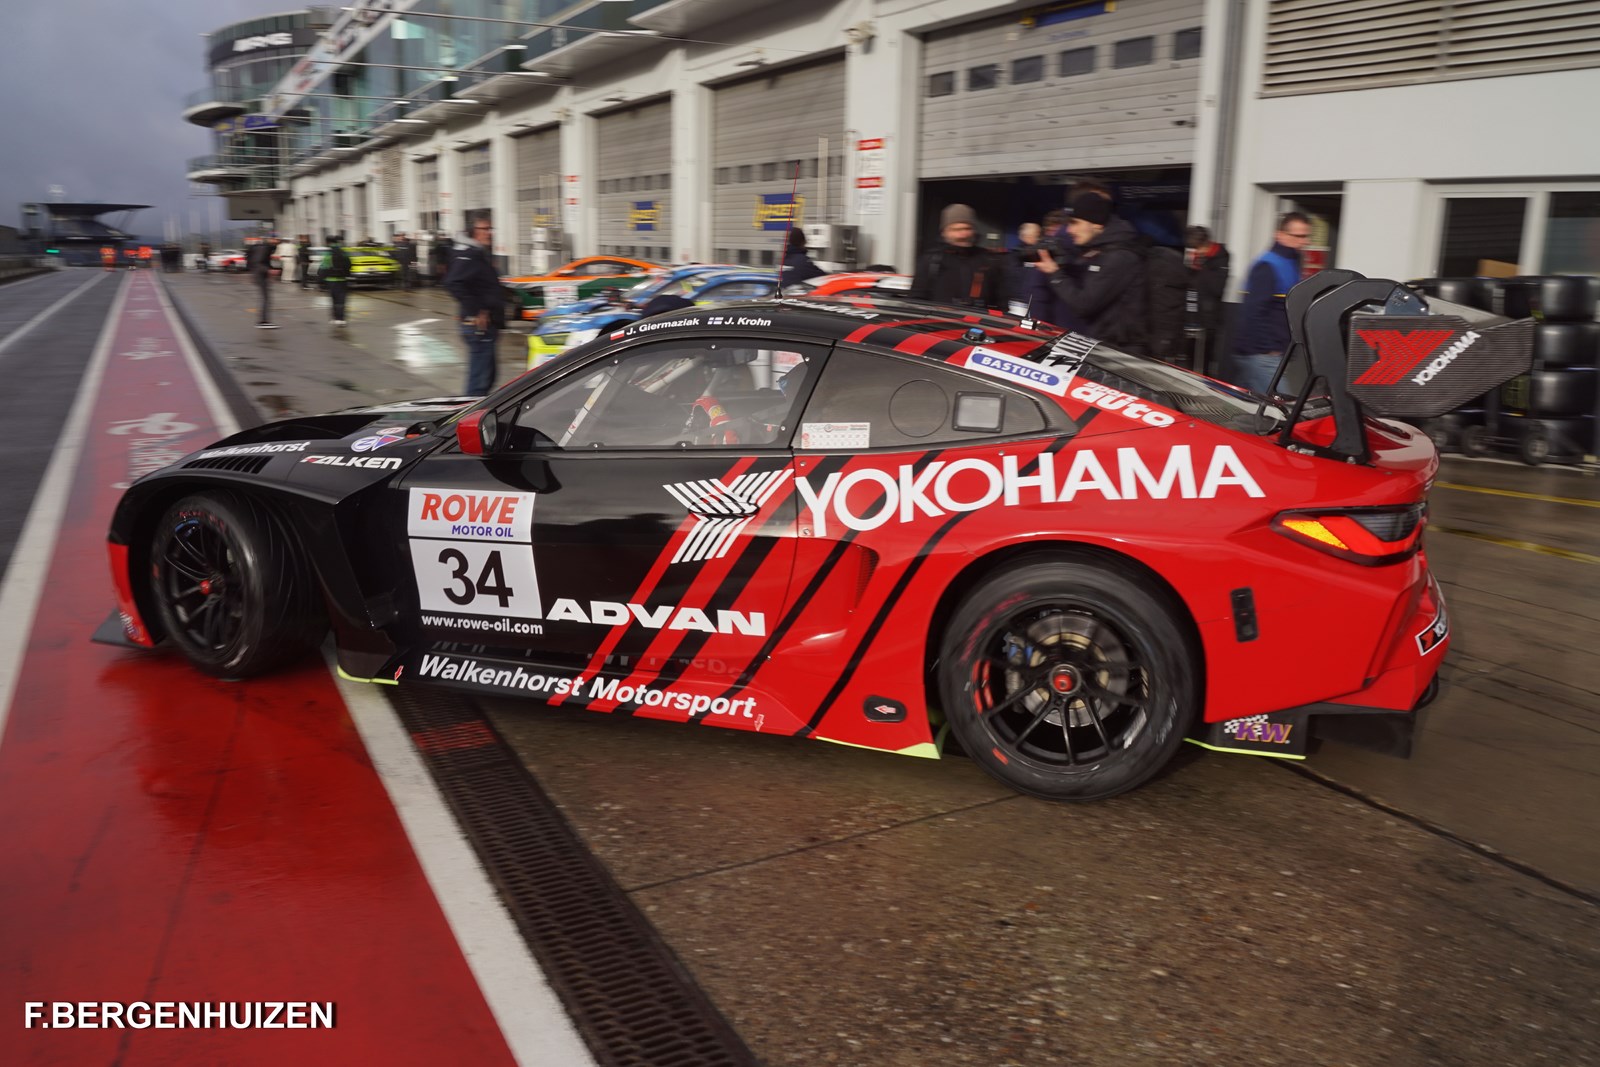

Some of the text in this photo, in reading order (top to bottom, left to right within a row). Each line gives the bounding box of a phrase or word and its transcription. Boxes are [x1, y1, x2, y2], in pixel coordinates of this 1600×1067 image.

[626, 317, 700, 336] J. Giermaziak
[724, 316, 771, 327] J. Krohn
[981, 356, 1053, 384] BASTUCK
[1411, 330, 1482, 386] YOKOHAMA
[1070, 387, 1176, 428] auto
[300, 455, 402, 470] FALKEN
[794, 445, 1266, 537] YOKOHAMA
[420, 493, 520, 524] ROWE
[452, 525, 514, 537] MOTOR OIL
[438, 548, 514, 608] 34
[421, 615, 543, 634] www.rowe-oil.com
[546, 598, 766, 636] ADVAN
[419, 655, 757, 718] Walkenhorst Motorsport
[1234, 723, 1293, 744] KW
